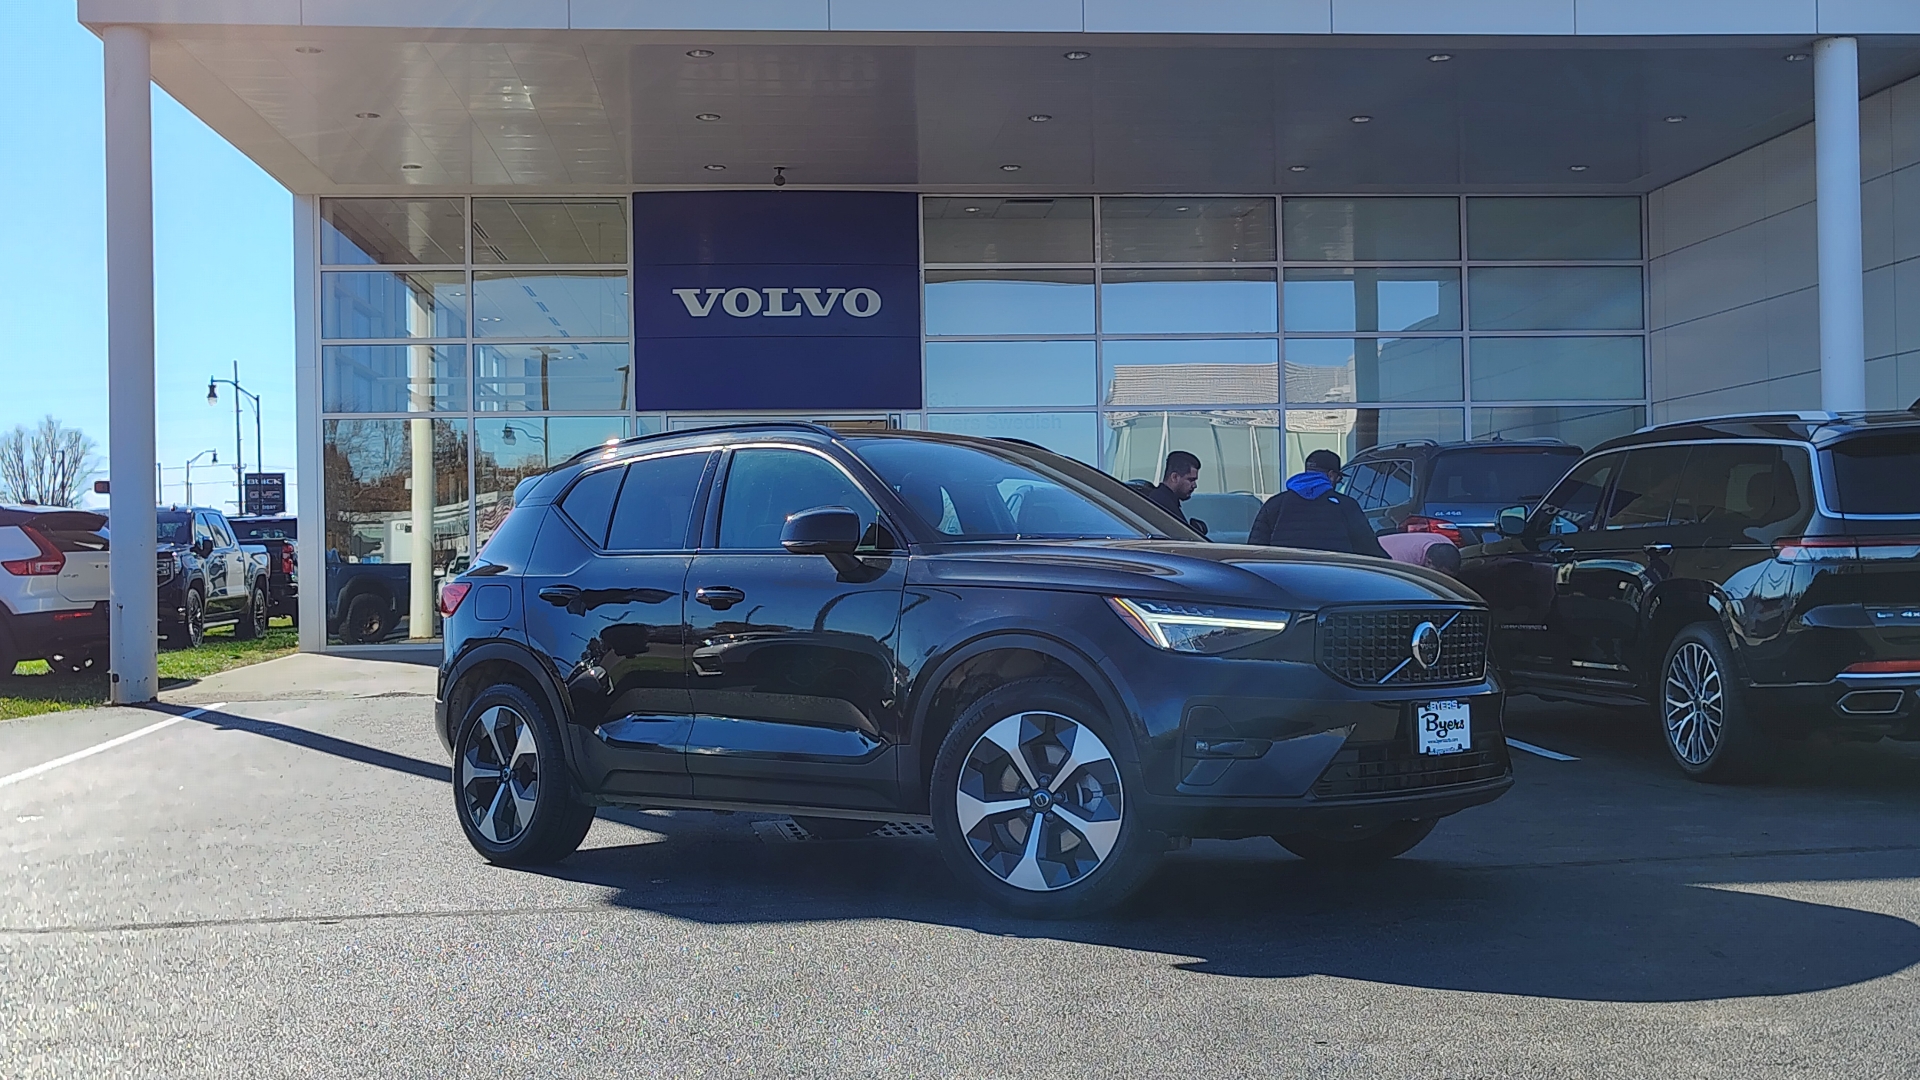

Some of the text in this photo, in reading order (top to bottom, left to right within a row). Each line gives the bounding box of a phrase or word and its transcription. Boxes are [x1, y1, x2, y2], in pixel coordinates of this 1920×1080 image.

[672, 287, 882, 317] VOLVO
[986, 414, 1062, 430] Swedish
[1429, 700, 1458, 711] BYERS
[1420, 712, 1465, 738] Byers
